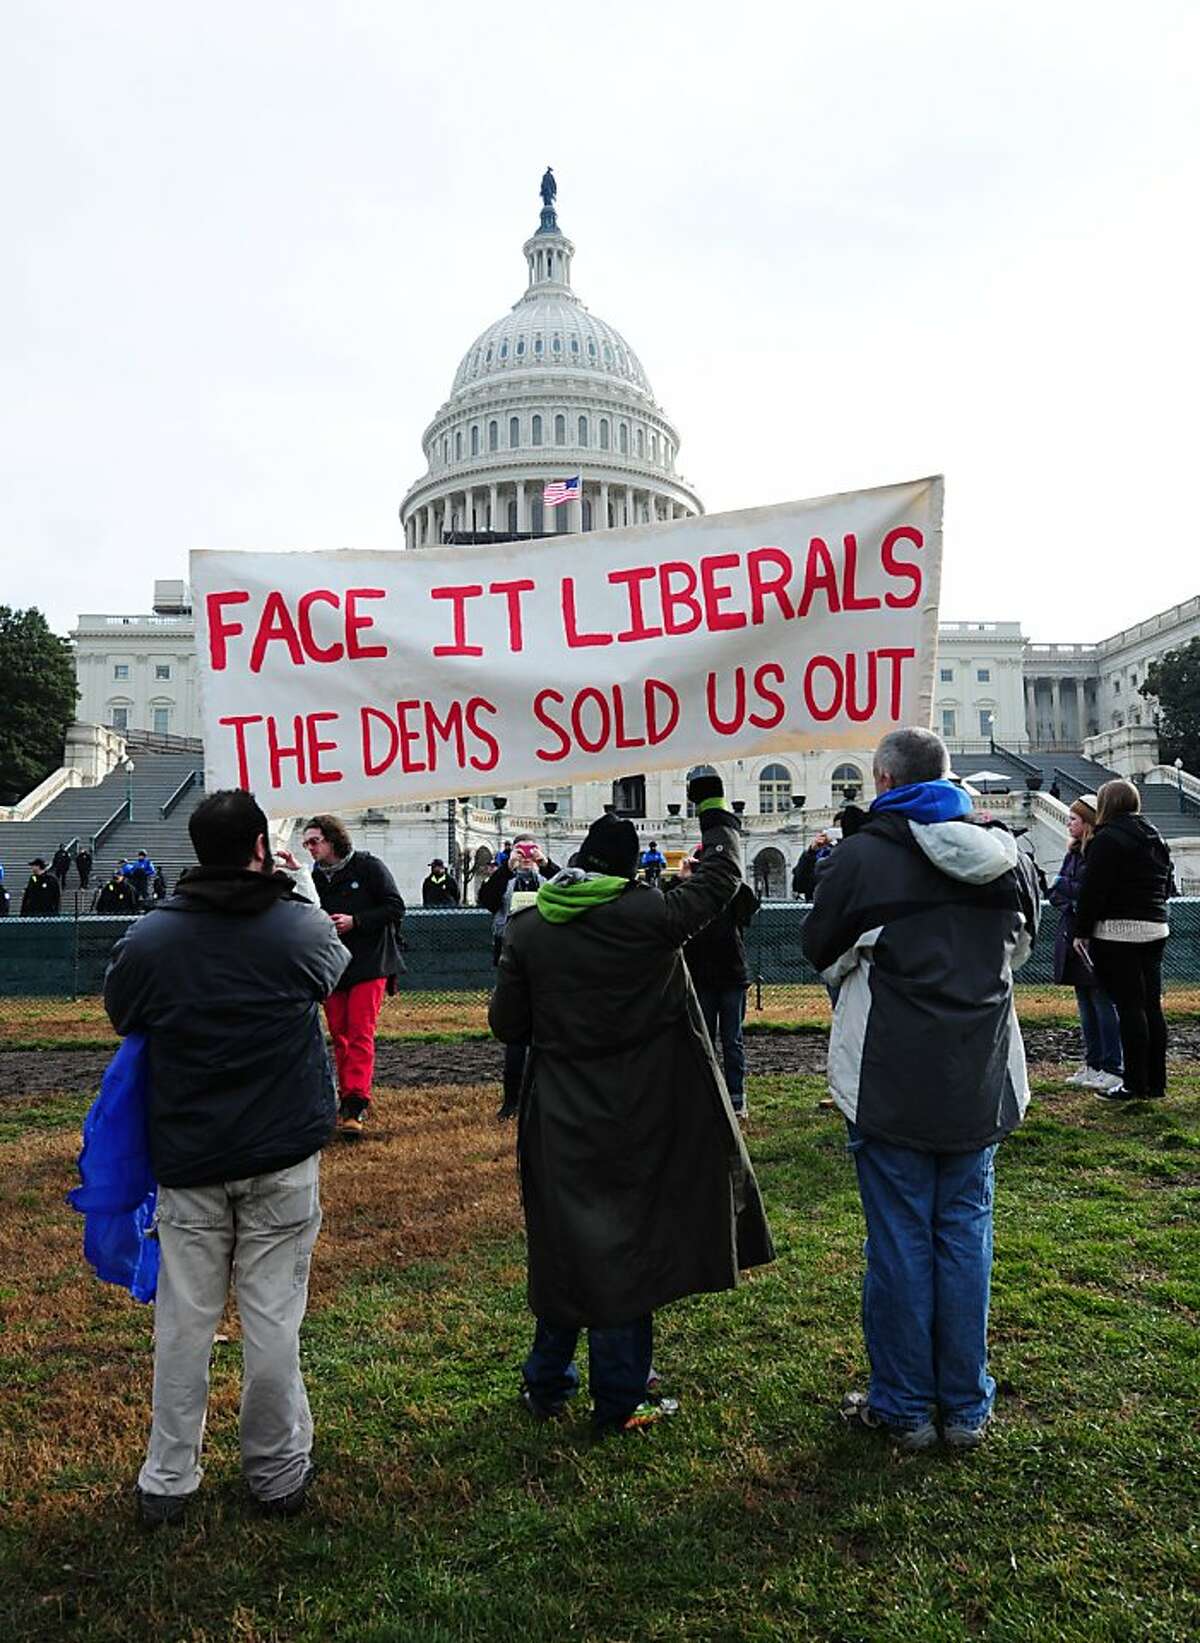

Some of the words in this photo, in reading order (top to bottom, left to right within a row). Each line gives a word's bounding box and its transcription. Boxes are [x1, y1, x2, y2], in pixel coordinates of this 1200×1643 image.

[206, 589, 388, 672] FACE
[431, 579, 535, 657] IT
[561, 525, 924, 649] LIBERALS
[218, 712, 343, 791] THE
[360, 697, 500, 777] DEMS
[533, 679, 680, 762] SOLD
[705, 662, 785, 736] US
[803, 648, 916, 722] OUT
